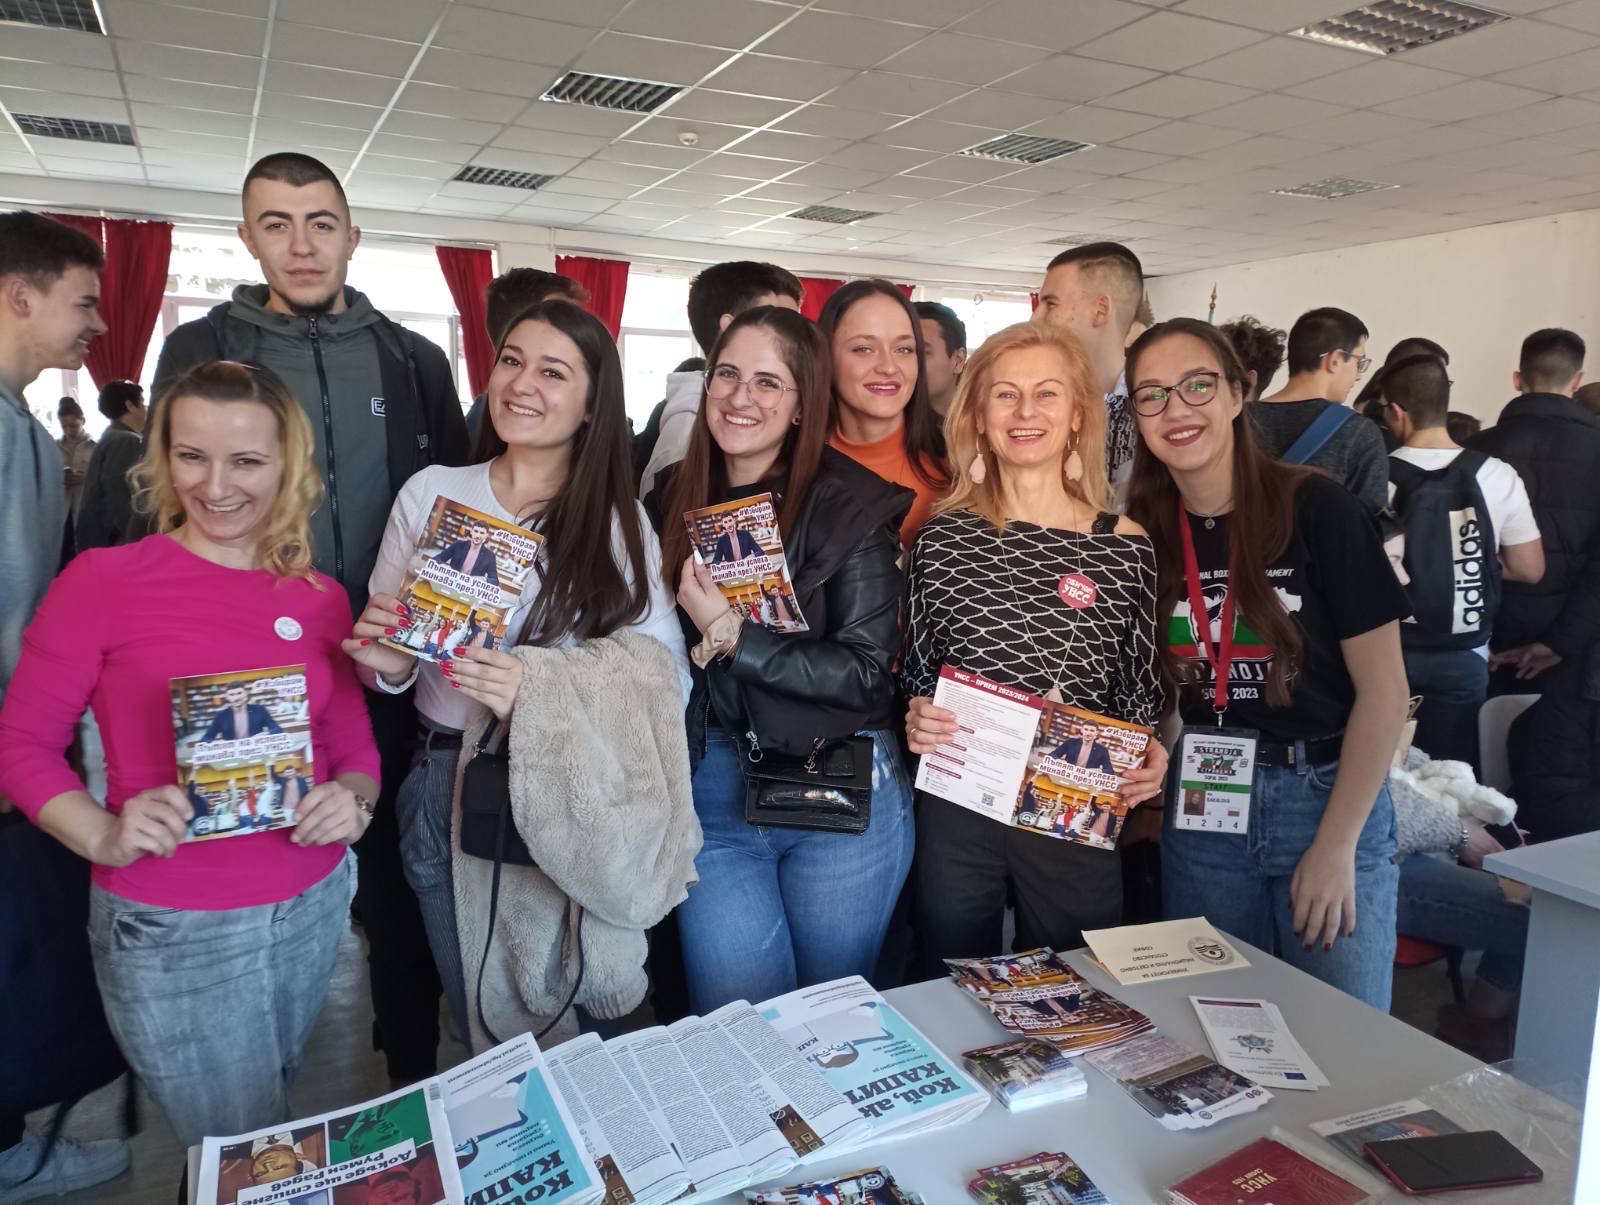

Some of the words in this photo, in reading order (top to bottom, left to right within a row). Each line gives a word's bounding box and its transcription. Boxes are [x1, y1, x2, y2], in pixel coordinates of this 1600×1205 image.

[739, 504, 771, 516] #Избирам
[756, 511, 773, 521] УНСС
[496, 530, 536, 551] #Избирам
[511, 545, 533, 560] УНСС
[711, 562, 736, 573] Пътят
[737, 560, 745, 568] на
[746, 556, 769, 568] успеха
[711, 570, 737, 581] минава
[738, 568, 753, 577] през
[753, 562, 772, 573] УНСС
[1213, 569, 1230, 579] BOX
[1455, 519, 1485, 626] adidas
[420, 569, 454, 587] минава
[455, 580, 475, 595] през
[476, 589, 500, 604] УНСС
[427, 560, 458, 579] Пътят
[460, 574, 470, 584] на
[472, 578, 500, 595] успеха
[1061, 583, 1091, 605] УНСС
[954, 671, 970, 682] УНСС
[975, 678, 998, 692] ПРИЕМ
[997, 685, 1030, 702] 2023/2024
[1232, 687, 1259, 699] 2023
[1106, 728, 1147, 743] #Избирам
[1124, 740, 1145, 750] УНСС
[1040, 764, 1071, 778] минава
[1072, 773, 1092, 785] през
[1094, 779, 1117, 790] УНСС
[1044, 756, 1074, 771] Пътят
[1076, 766, 1086, 775] на
[1088, 770, 1116, 783] успеха
[1201, 819, 1207, 827] 2
[1217, 820, 1223, 828] 3
[843, 1061, 945, 1105] КАПИТ
[892, 1076, 961, 1105] Кой,
[858, 1099, 895, 1118] ак
[328, 1152, 385, 1173] Румен
[345, 1149, 412, 1180] Докъде
[271, 1171, 325, 1192] Радев
[314, 1175, 342, 1188] ще
[464, 1149, 565, 1205] КАПИ
[1240, 1172, 1278, 1193] УНСС
[241, 1184, 312, 1205] стигне
